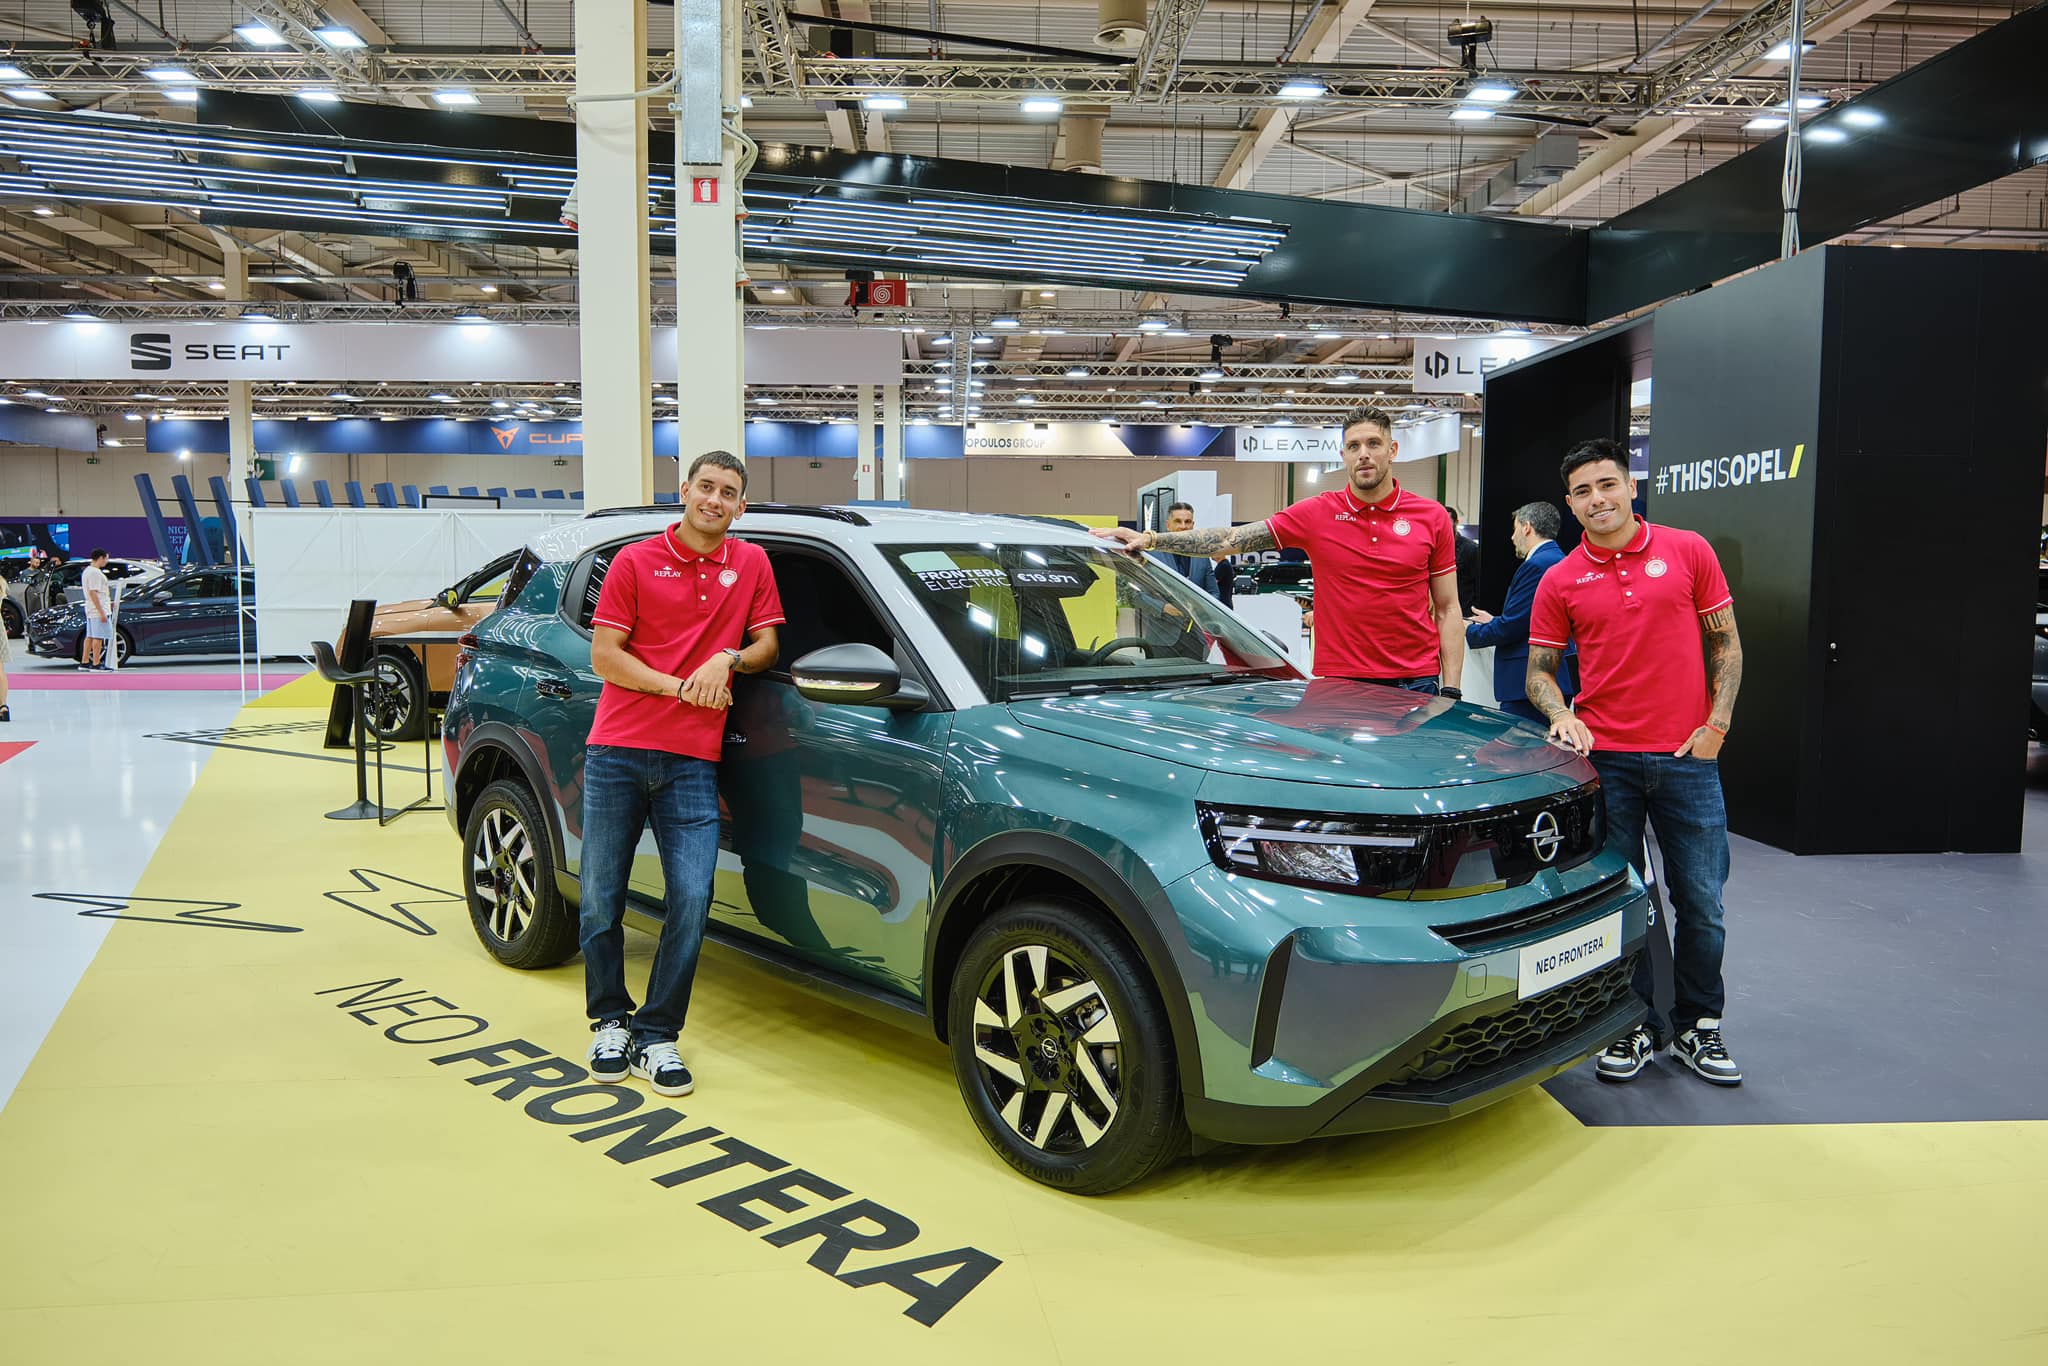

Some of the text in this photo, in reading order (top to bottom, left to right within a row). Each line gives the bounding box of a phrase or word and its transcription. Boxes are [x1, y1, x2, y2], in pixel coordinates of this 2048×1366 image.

[185, 345, 290, 360] SEAT
[1262, 439, 1344, 450] LEAPM
[916, 568, 1008, 582] FRONTERA
[1017, 573, 1079, 585] €19.971
[1576, 573, 1605, 584] REPLAY
[925, 577, 1011, 592] ELECTRIC
[1535, 936, 1604, 975] NEO FRONTERA
[314, 977, 1003, 1329] NEO FRONTERA
